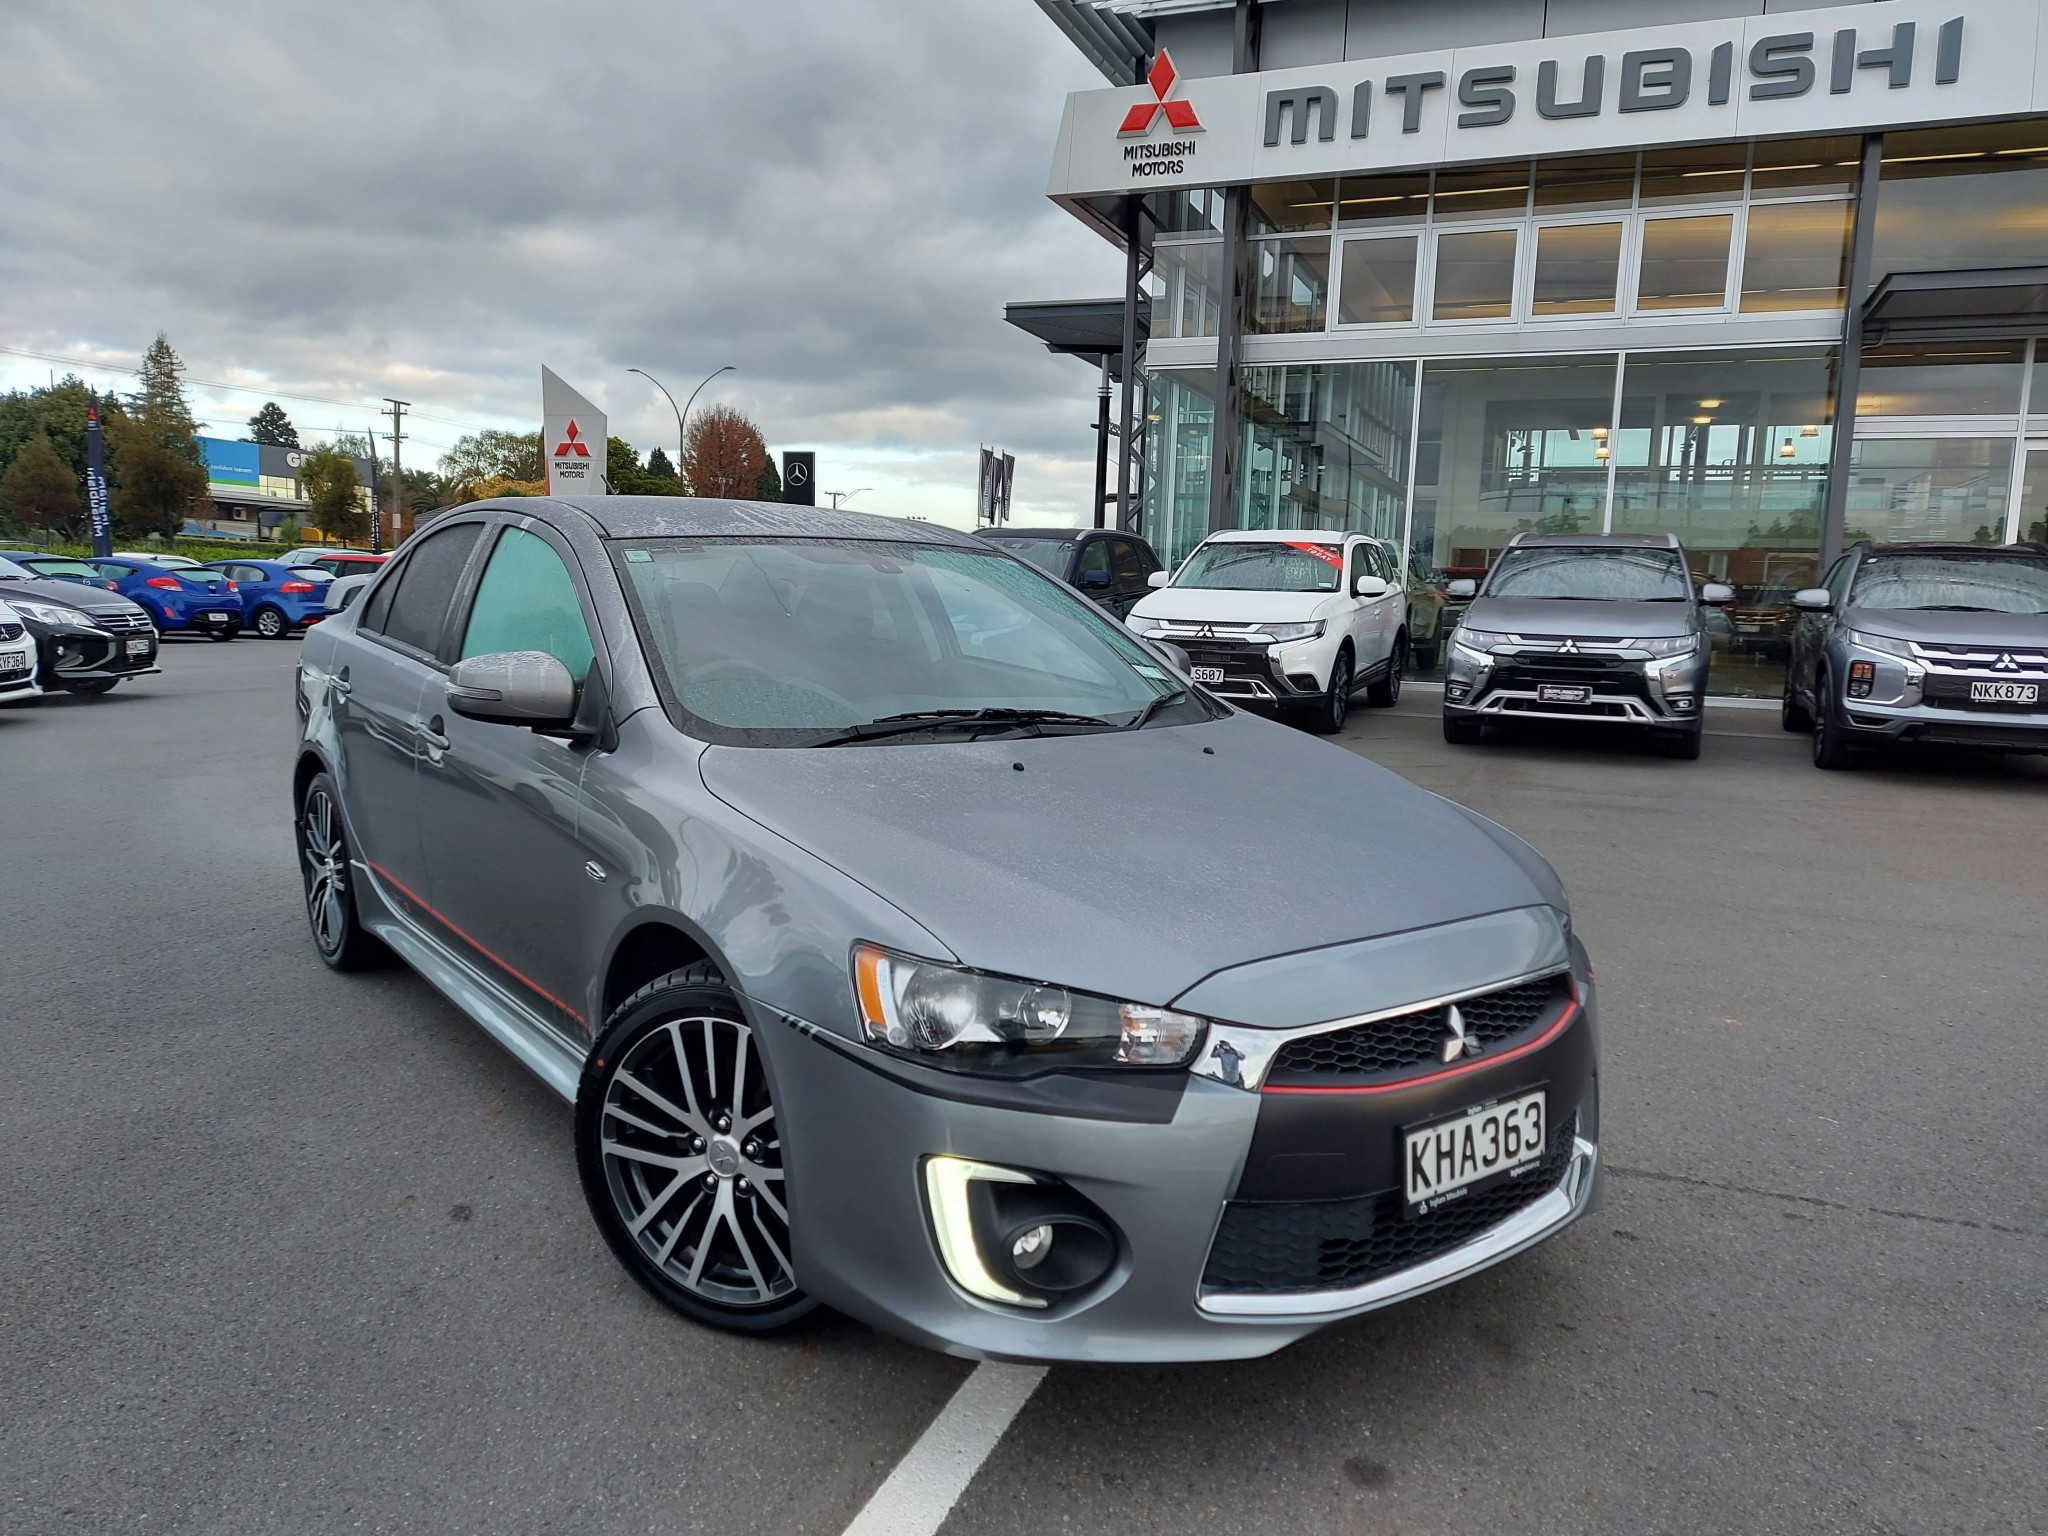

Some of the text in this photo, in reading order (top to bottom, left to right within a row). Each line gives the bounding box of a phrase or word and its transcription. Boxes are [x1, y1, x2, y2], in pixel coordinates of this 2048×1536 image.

[1262, 15, 1965, 148] MITSUBISHI
[1123, 140, 1197, 161] MITSUBISHI
[1131, 159, 1185, 178] MOTORS
[554, 461, 590, 470] MITSUBISHI
[559, 470, 585, 479] MOTORS
[1306, 547, 1333, 561] TODAY
[1973, 683, 2037, 700] NKK873
[1411, 1100, 1543, 1194] KHA363
